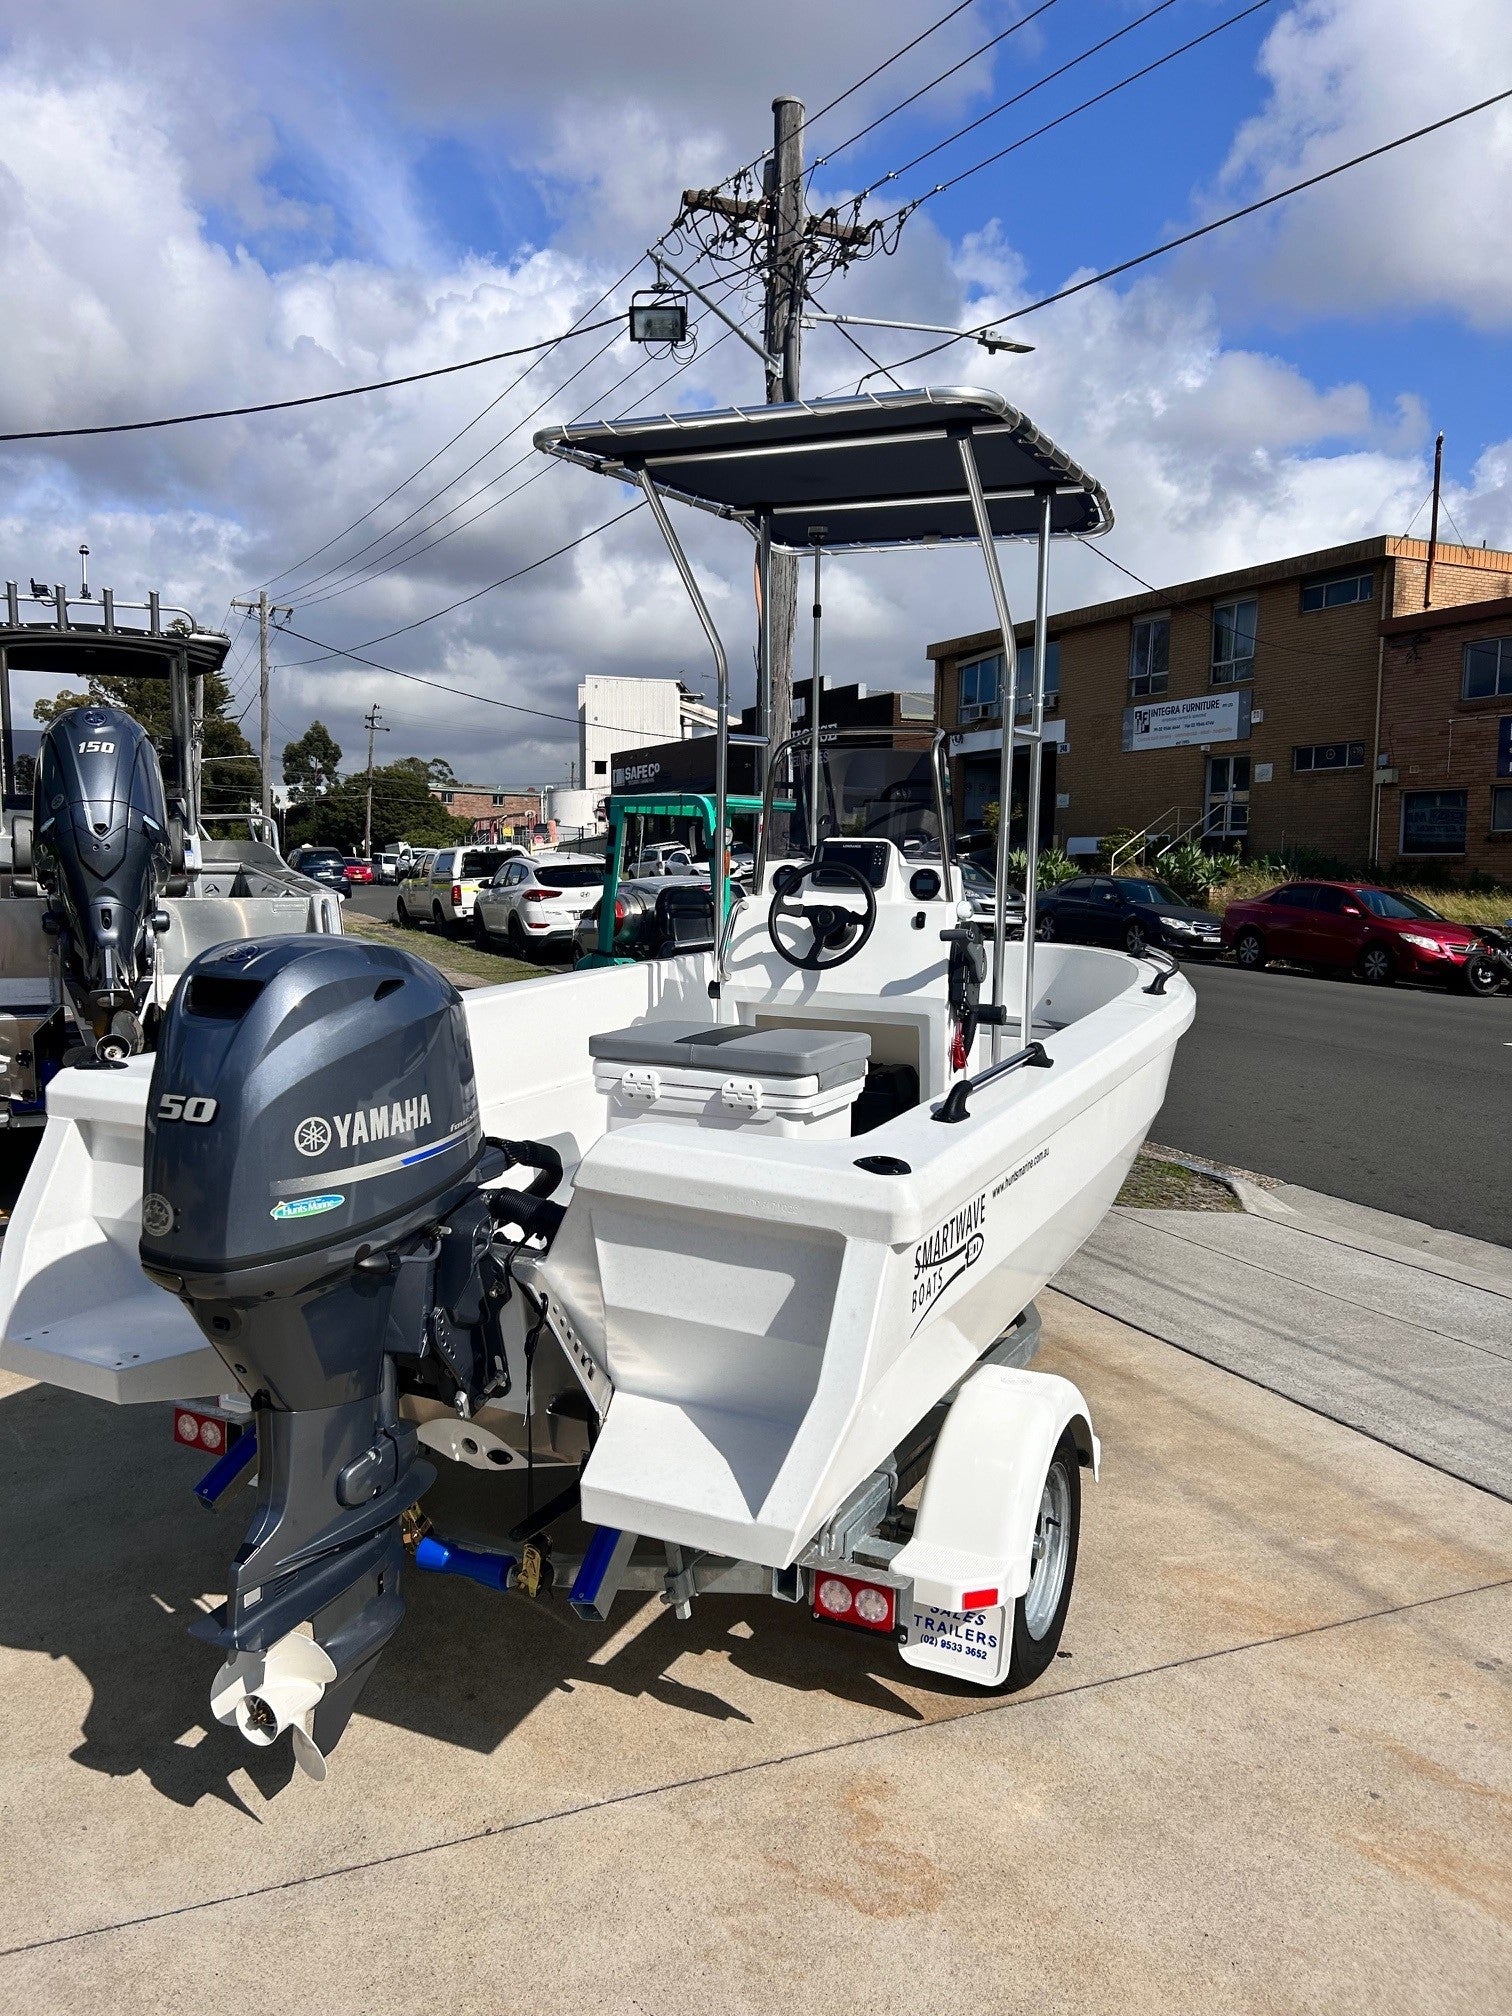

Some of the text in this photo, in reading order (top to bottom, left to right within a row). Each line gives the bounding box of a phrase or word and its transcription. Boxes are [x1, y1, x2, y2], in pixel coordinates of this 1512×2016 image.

[1150, 705, 1180, 718] INTEGRA
[1182, 699, 1220, 713] FURNITURE
[78, 741, 116, 754] 150
[157, 1093, 219, 1125] 50
[333, 1094, 431, 1148] YAMAHA
[992, 1147, 1049, 1199] www.huntsmarine.com.au
[283, 1204, 308, 1215] Hunts
[914, 1193, 986, 1280] SMARTWAVE
[912, 1266, 943, 1313] BOATS
[914, 1614, 998, 1648] TRAILERS
[920, 1634, 988, 1660] (02) 9533 3652
